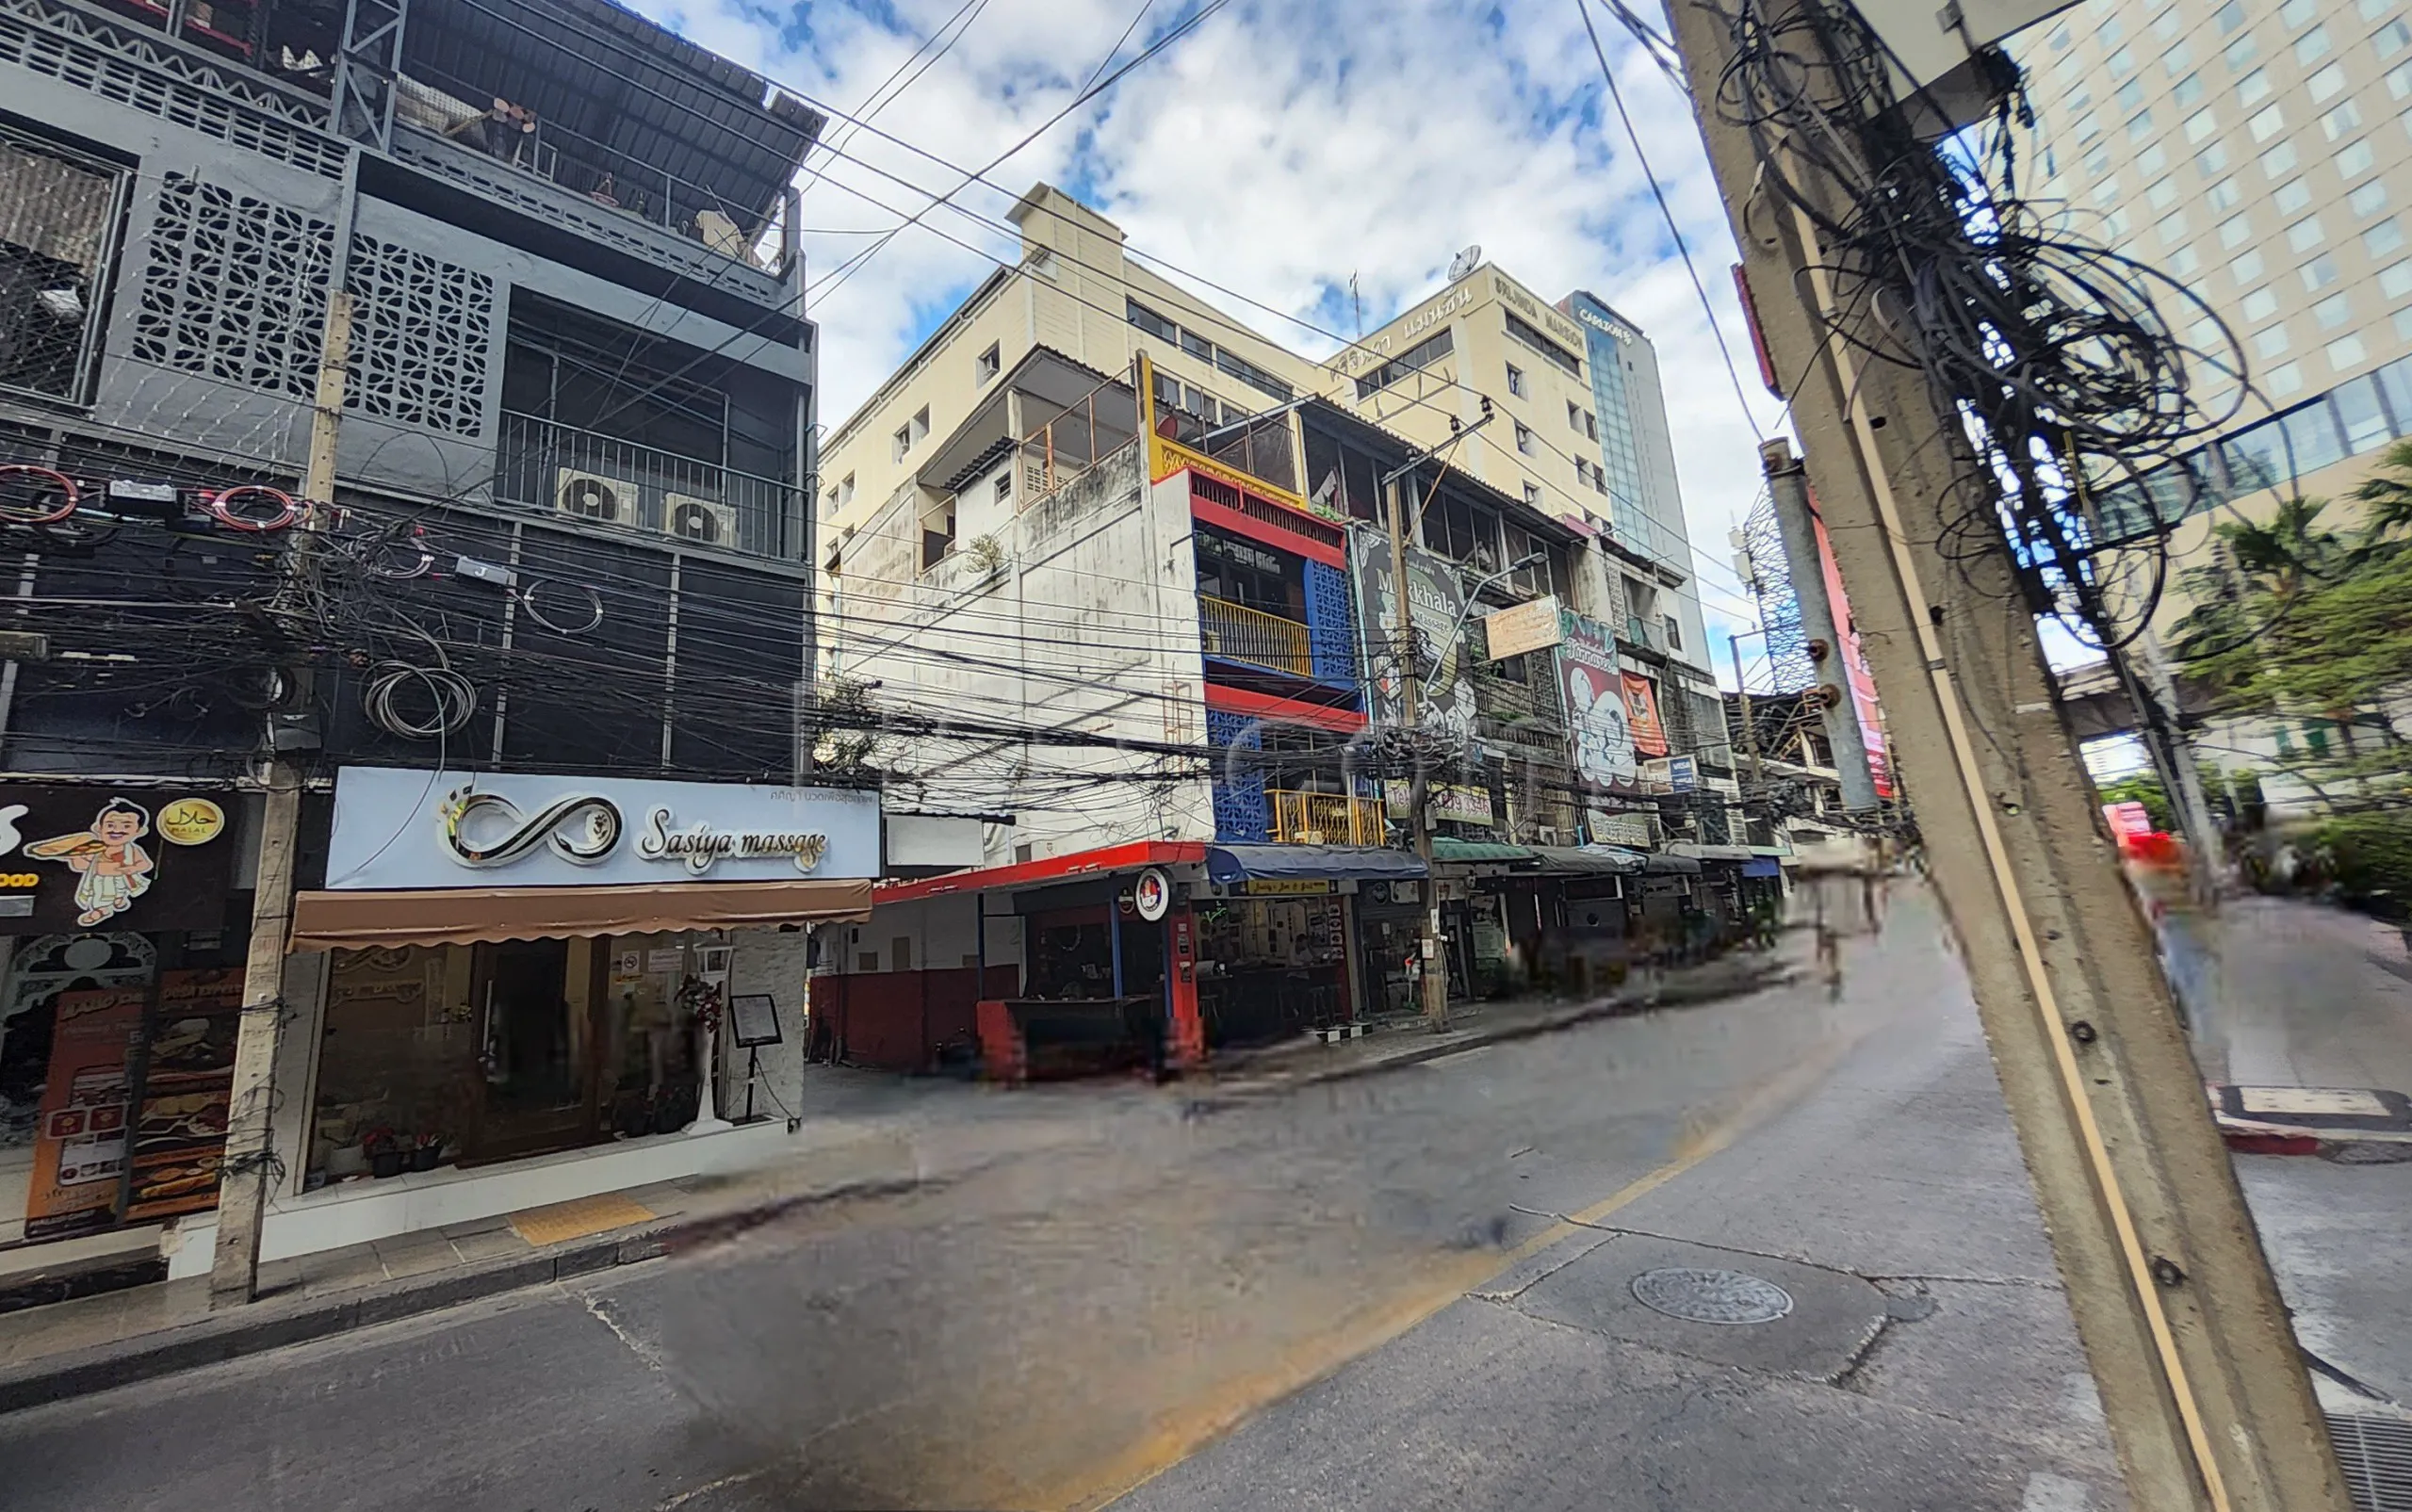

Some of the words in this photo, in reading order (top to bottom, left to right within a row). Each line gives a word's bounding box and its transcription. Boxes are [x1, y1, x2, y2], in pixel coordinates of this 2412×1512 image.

[1377, 567, 1459, 618] Mkkhala
[167, 807, 218, 826] حلال
[642, 808, 733, 870] Sasiya
[741, 832, 826, 868] massage
